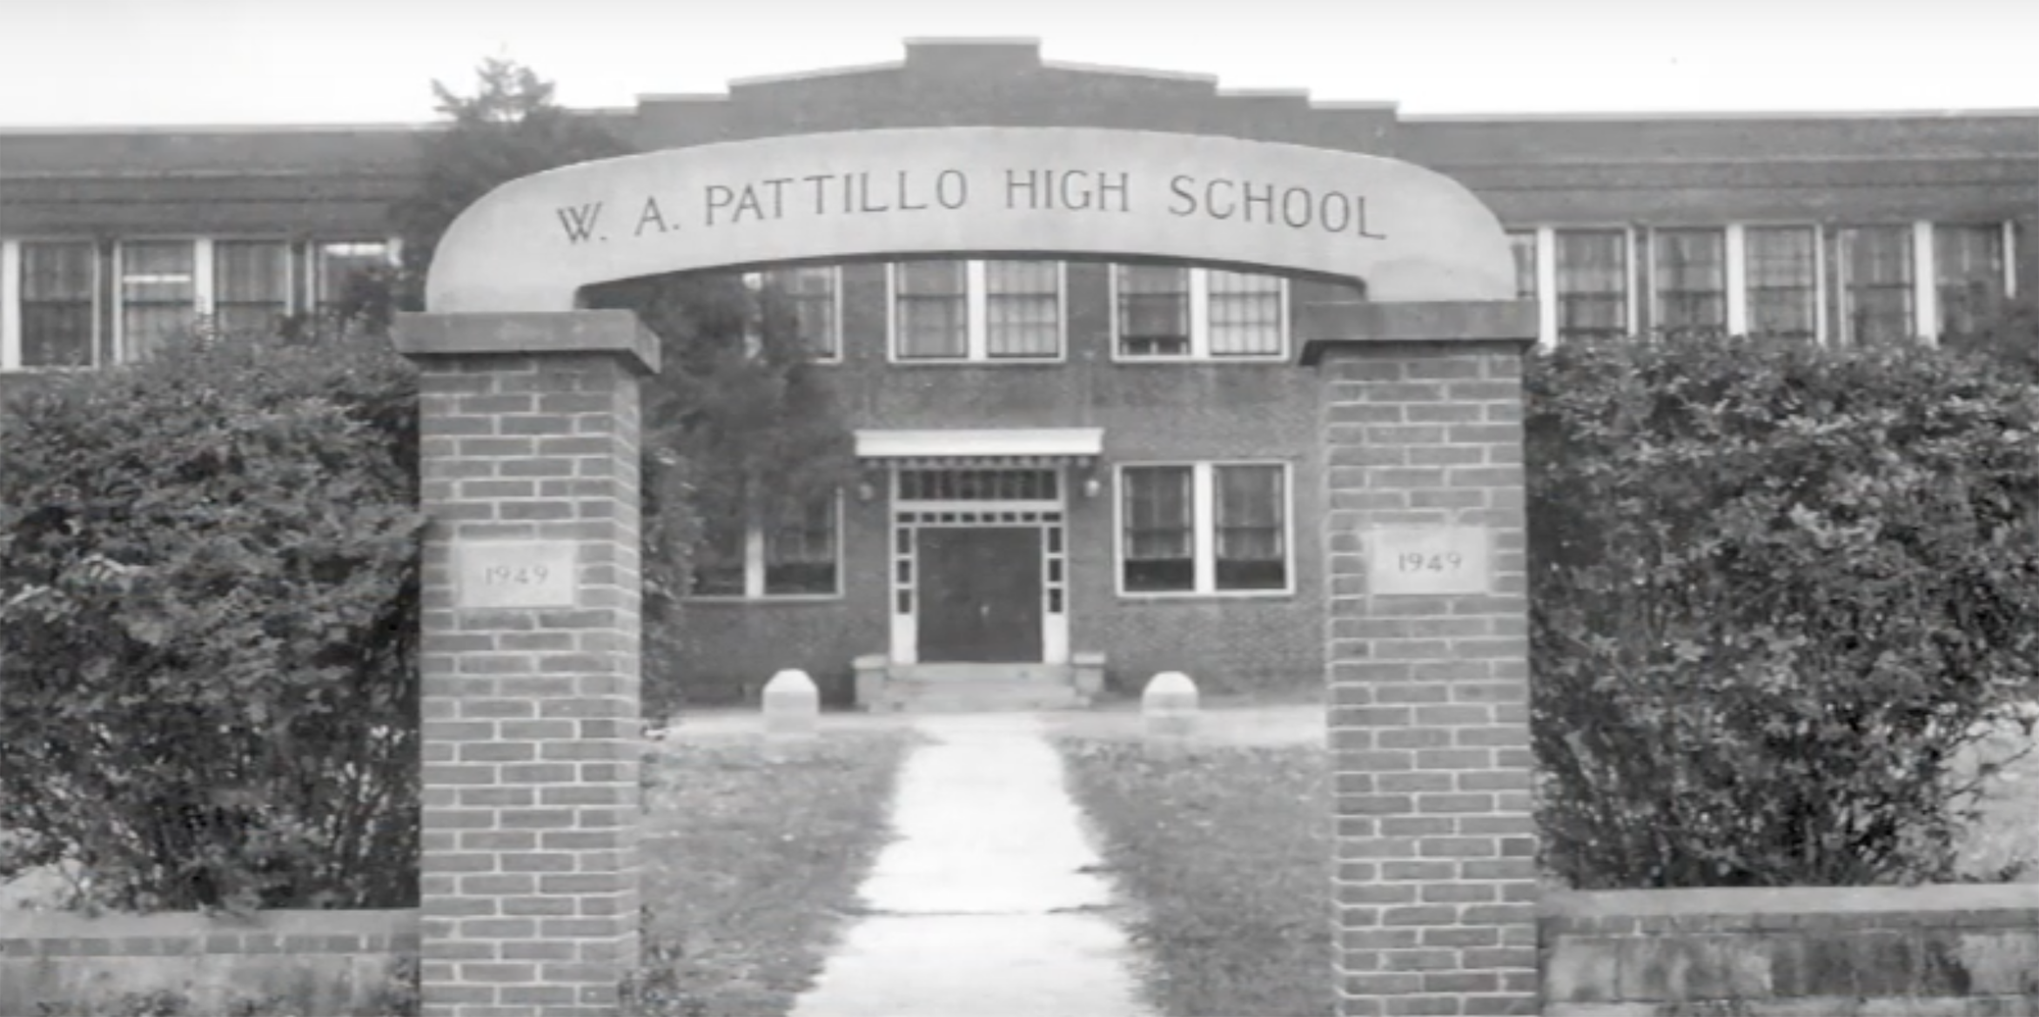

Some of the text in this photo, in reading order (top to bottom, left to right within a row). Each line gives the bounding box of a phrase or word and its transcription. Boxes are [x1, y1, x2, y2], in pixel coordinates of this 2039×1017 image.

[556, 168, 1388, 245] W. A. PATTILLO HIGH SCHOOL
[1398, 551, 1463, 573] 1949
[484, 565, 549, 586] 1949
